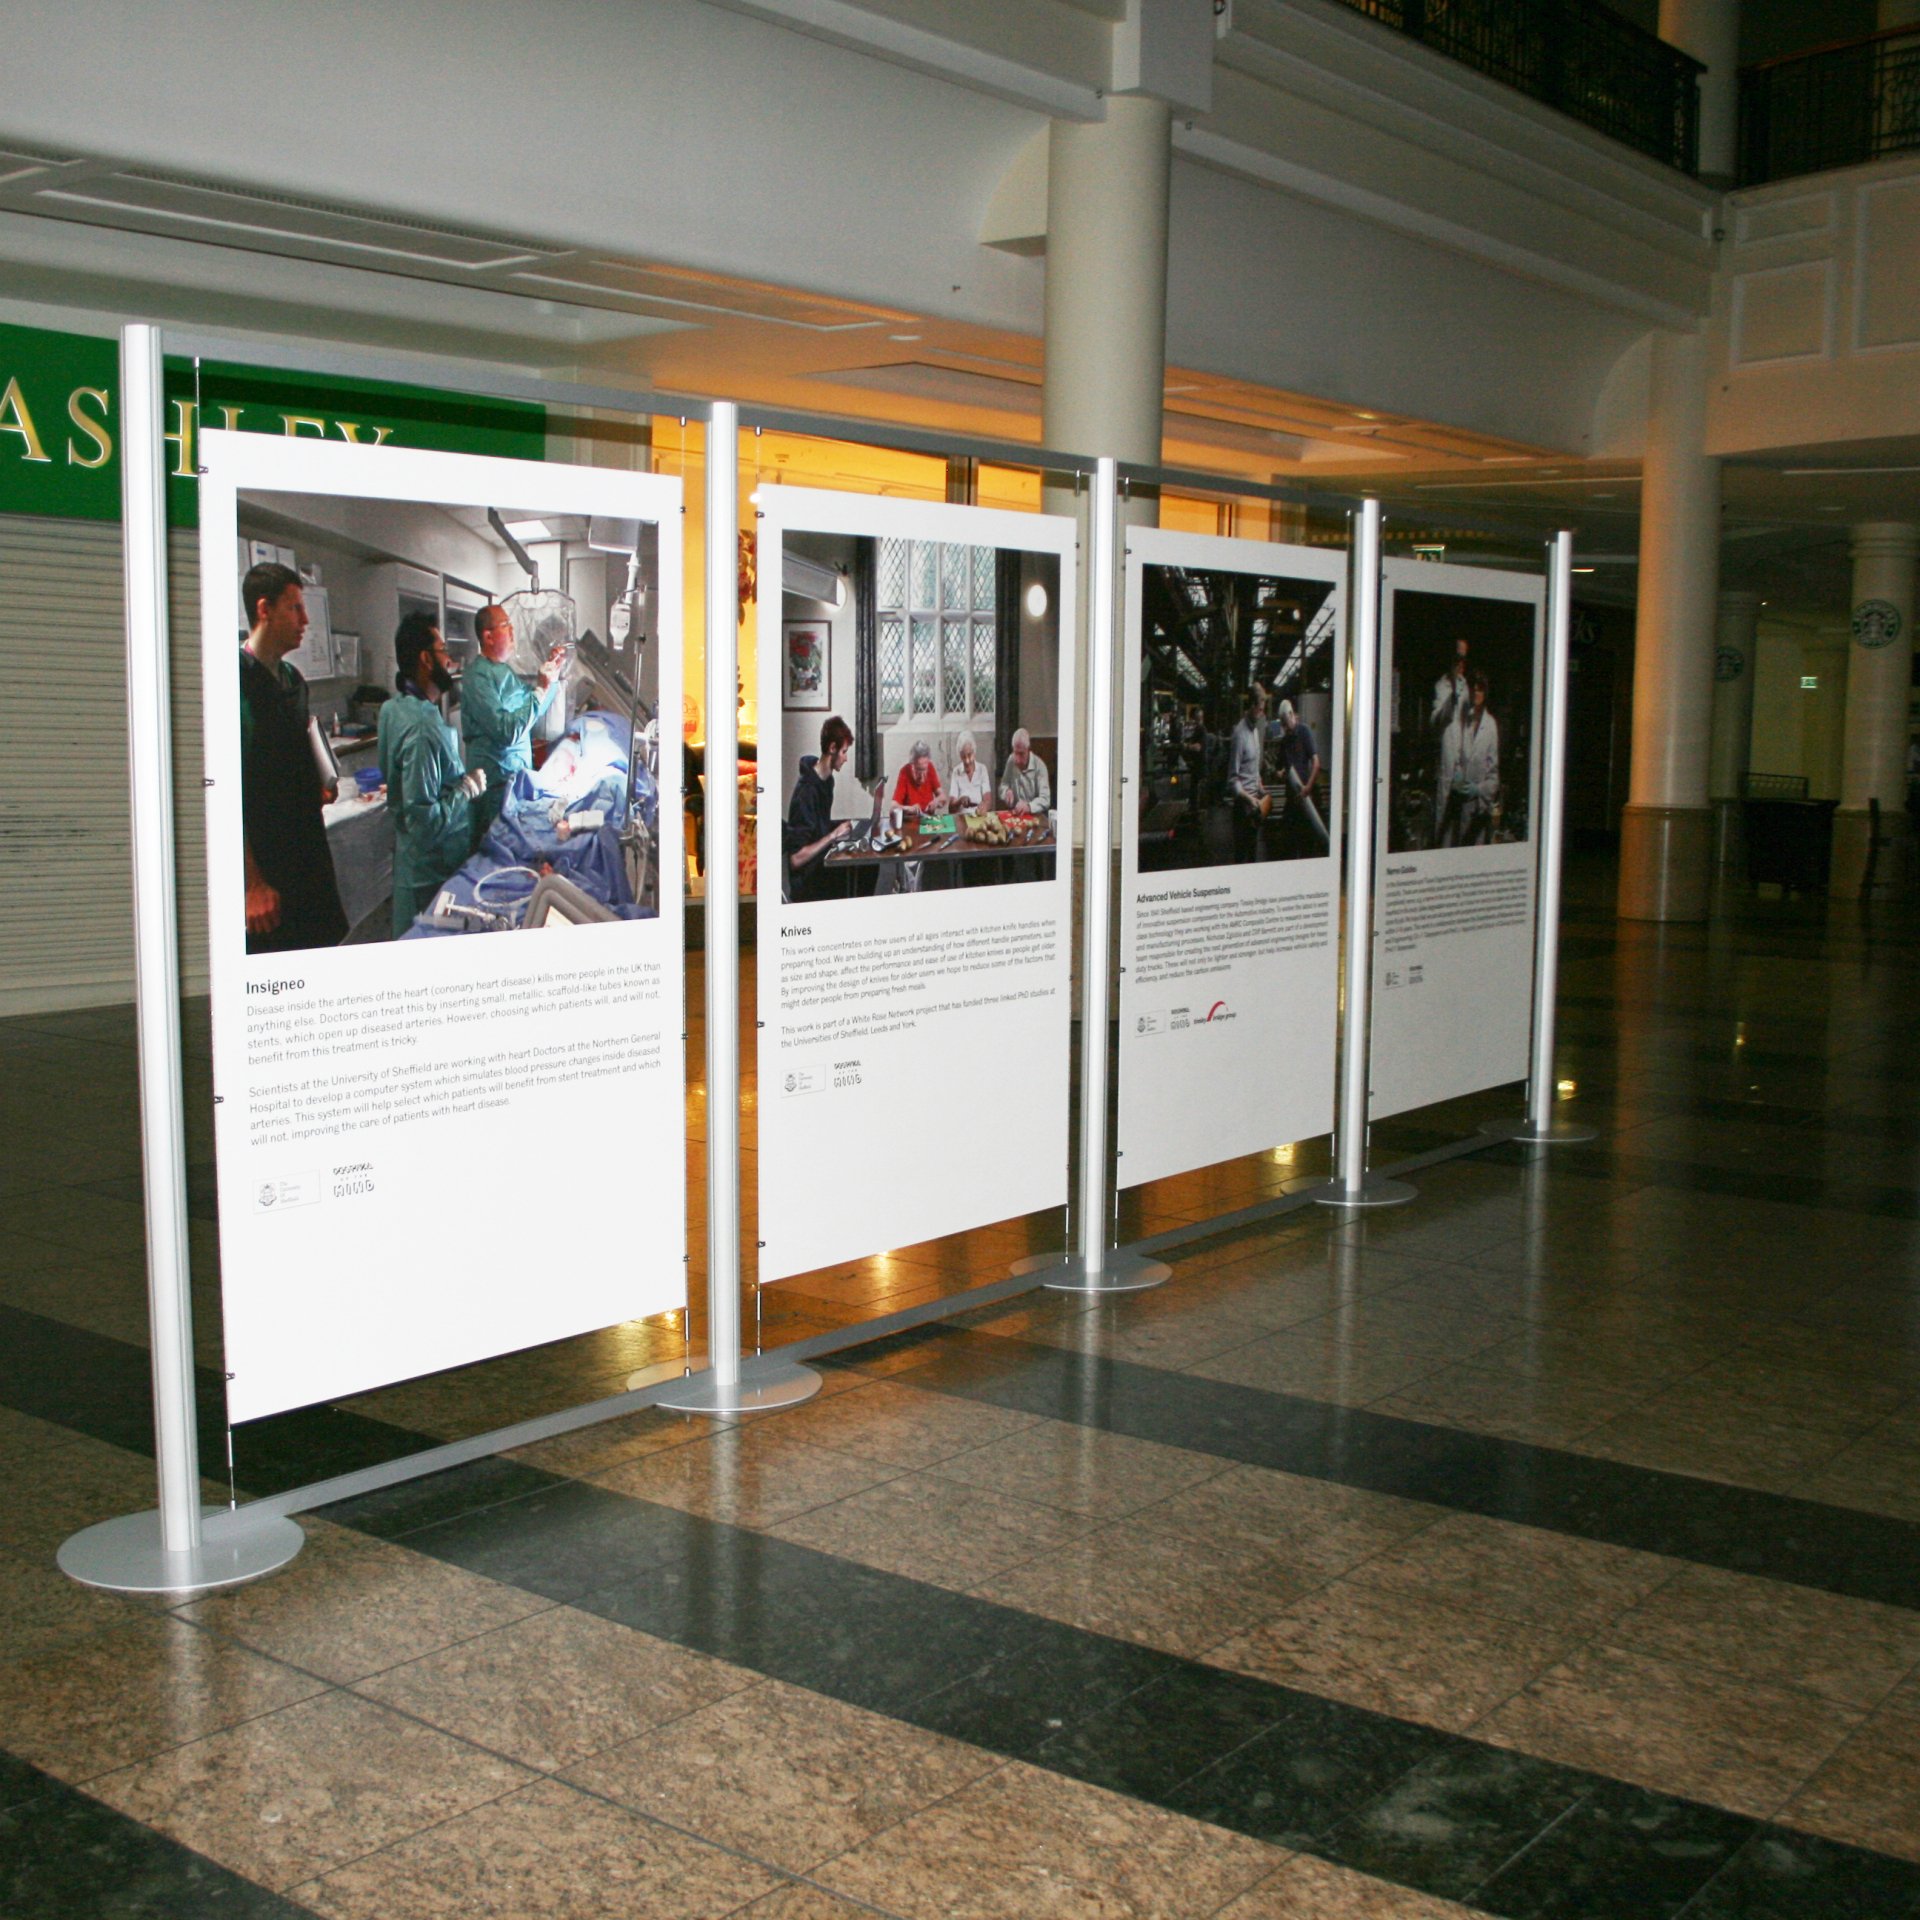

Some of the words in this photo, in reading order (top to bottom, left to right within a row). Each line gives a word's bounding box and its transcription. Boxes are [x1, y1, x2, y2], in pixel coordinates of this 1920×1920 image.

[1136, 891, 1168, 903] Advanced
[1169, 889, 1191, 899] Vehicle
[1192, 887, 1230, 897] Suspensions
[780, 926, 811, 937] Knives
[781, 947, 796, 955] This
[797, 944, 815, 954] work
[816, 941, 862, 951] concentrates
[888, 936, 906, 944] users
[908, 933, 914, 942] of
[915, 932, 923, 941] all
[780, 959, 813, 970] preparing
[833, 954, 843, 962] We
[857, 950, 882, 960] building
[246, 979, 304, 995] Insigneo
[246, 1004, 284, 1016] Disease
[287, 999, 316, 1011] inside
[318, 998, 334, 1007] the
[336, 994, 373, 1005] arteries
[375, 991, 384, 1001] of
[386, 990, 401, 1000] the
[404, 987, 428, 997] heart
[430, 983, 473, 996] (coronary
[476, 979, 498, 989] heart
[500, 975, 535, 987] disease)
[537, 973, 553, 983] kills
[555, 972, 577, 980] more
[578, 968, 605, 980] people
[607, 966, 614, 975] in
[616, 965, 629, 974] the
[630, 963, 642, 973] UK
[643, 962, 660, 971] than
[780, 986, 789, 997] By
[790, 983, 824, 994] improving
[825, 981, 837, 989] the
[838, 979, 860, 988] design
[780, 999, 799, 1009] might
[801, 997, 819, 1005] deter
[820, 993, 842, 1004] people
[843, 991, 859, 999] from
[860, 987, 890, 998] preparing
[891, 984, 907, 992] fresh
[247, 1019, 291, 1033] anything
[319, 1012, 358, 1023] Doctors
[361, 1009, 377, 1019] can
[380, 1005, 403, 1016] treat
[406, 1002, 424, 1013] this
[426, 1001, 437, 1013] by
[439, 996, 479, 1008] inserting
[547, 983, 596, 996] scaffold-like
[599, 981, 621, 990] tubes
[623, 978, 649, 987] known
[285, 1031, 315, 1043] which
[318, 1029, 342, 1041] open
[345, 1028, 358, 1038] up
[360, 1020, 402, 1034] diseased
[490, 1006, 529, 1018] choosing
[531, 1001, 556, 1012] which
[558, 998, 592, 1011] patients
[612, 993, 627, 1003] and
[629, 991, 643, 1001] will
[781, 1025, 795, 1034] This
[796, 1023, 814, 1032] work
[822, 1019, 836, 1030] part
[837, 1017, 844, 1026] of
[851, 1015, 870, 1023] White
[871, 1012, 886, 1020] Rose
[888, 1008, 914, 1018] Network
[781, 1039, 792, 1048] the
[793, 1034, 831, 1046] Universities
[832, 1031, 839, 1040] of
[870, 1024, 888, 1034] Leeds
[889, 1021, 900, 1031] and
[248, 1051, 282, 1064] benefit
[285, 1049, 309, 1059] from
[312, 1046, 329, 1056] this
[332, 1039, 378, 1053] treatment
[381, 1038, 389, 1047] is
[248, 1083, 298, 1097] Scientists
[300, 1080, 309, 1090] at
[312, 1078, 328, 1088] the
[331, 1071, 378, 1085] University
[380, 1067, 389, 1078] of
[392, 1062, 431, 1076] Sheffield
[433, 1062, 448, 1071] are
[450, 1056, 485, 1068] working
[487, 1052, 506, 1062] with
[508, 1049, 530, 1059] heart
[532, 1045, 565, 1056] Doctors
[567, 1042, 575, 1052] at
[577, 1041, 590, 1050] the
[592, 1037, 628, 1047] Northern
[630, 1031, 660, 1043] General
[249, 1099, 290, 1112] Hospital
[292, 1098, 303, 1107] to
[305, 1092, 343, 1105] develop
[345, 1091, 350, 1099] a
[353, 1084, 398, 1098] computer
[400, 1079, 432, 1092] system
[434, 1073, 460, 1085] which
[462, 1069, 502, 1081] simulates
[504, 1063, 528, 1075] blood
[530, 1060, 566, 1073] pressure
[568, 1055, 600, 1066] changes
[602, 1050, 625, 1060] inside
[627, 1045, 660, 1057] diseased
[296, 1111, 315, 1122] This
[317, 1107, 351, 1121] system
[353, 1102, 369, 1113] will
[371, 1099, 391, 1110] help
[393, 1094, 420, 1107] select
[422, 1090, 449, 1102] which
[451, 1086, 486, 1100] patients
[488, 1081, 503, 1092] will
[504, 1077, 533, 1089] benefit
[536, 1076, 556, 1085] from
[558, 1071, 578, 1082] stent
[580, 1065, 620, 1078] treatment
[622, 1062, 636, 1072] and
[637, 1059, 660, 1069] which
[250, 1134, 267, 1145] will
[291, 1124, 339, 1139] improving
[341, 1121, 357, 1131] the
[359, 1118, 379, 1128] care
[381, 1114, 390, 1124] of
[393, 1110, 429, 1124] patients
[431, 1105, 450, 1116] with
[452, 1101, 475, 1112] heart
